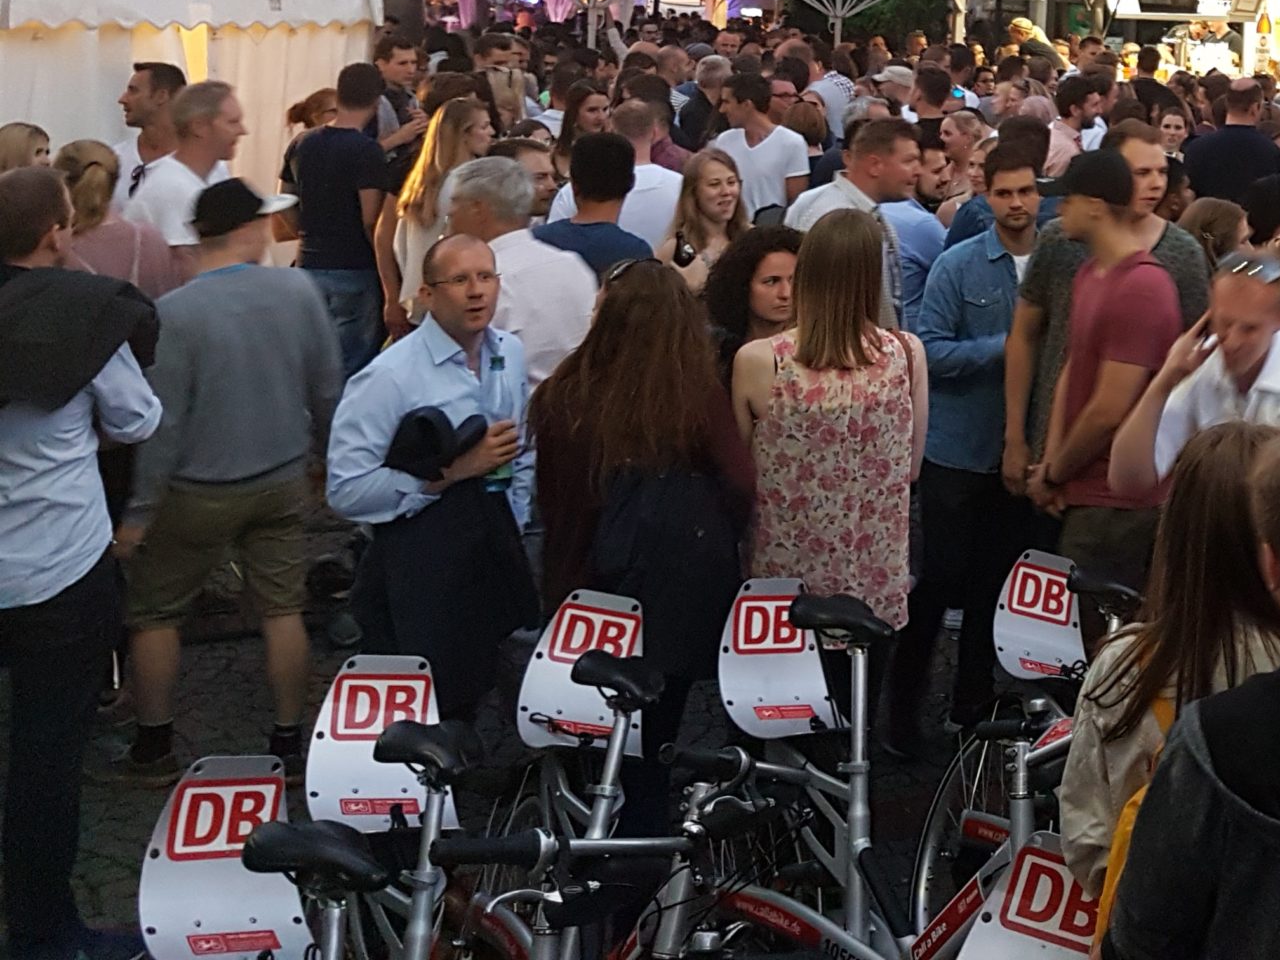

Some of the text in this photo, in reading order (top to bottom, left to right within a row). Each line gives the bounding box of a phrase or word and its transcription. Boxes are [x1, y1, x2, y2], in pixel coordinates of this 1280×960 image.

[1016, 570, 1066, 616] DB
[560, 613, 627, 657] DB
[743, 605, 798, 645] DB
[344, 684, 417, 730] DB
[182, 790, 266, 847] DB
[1015, 861, 1099, 938] DB
